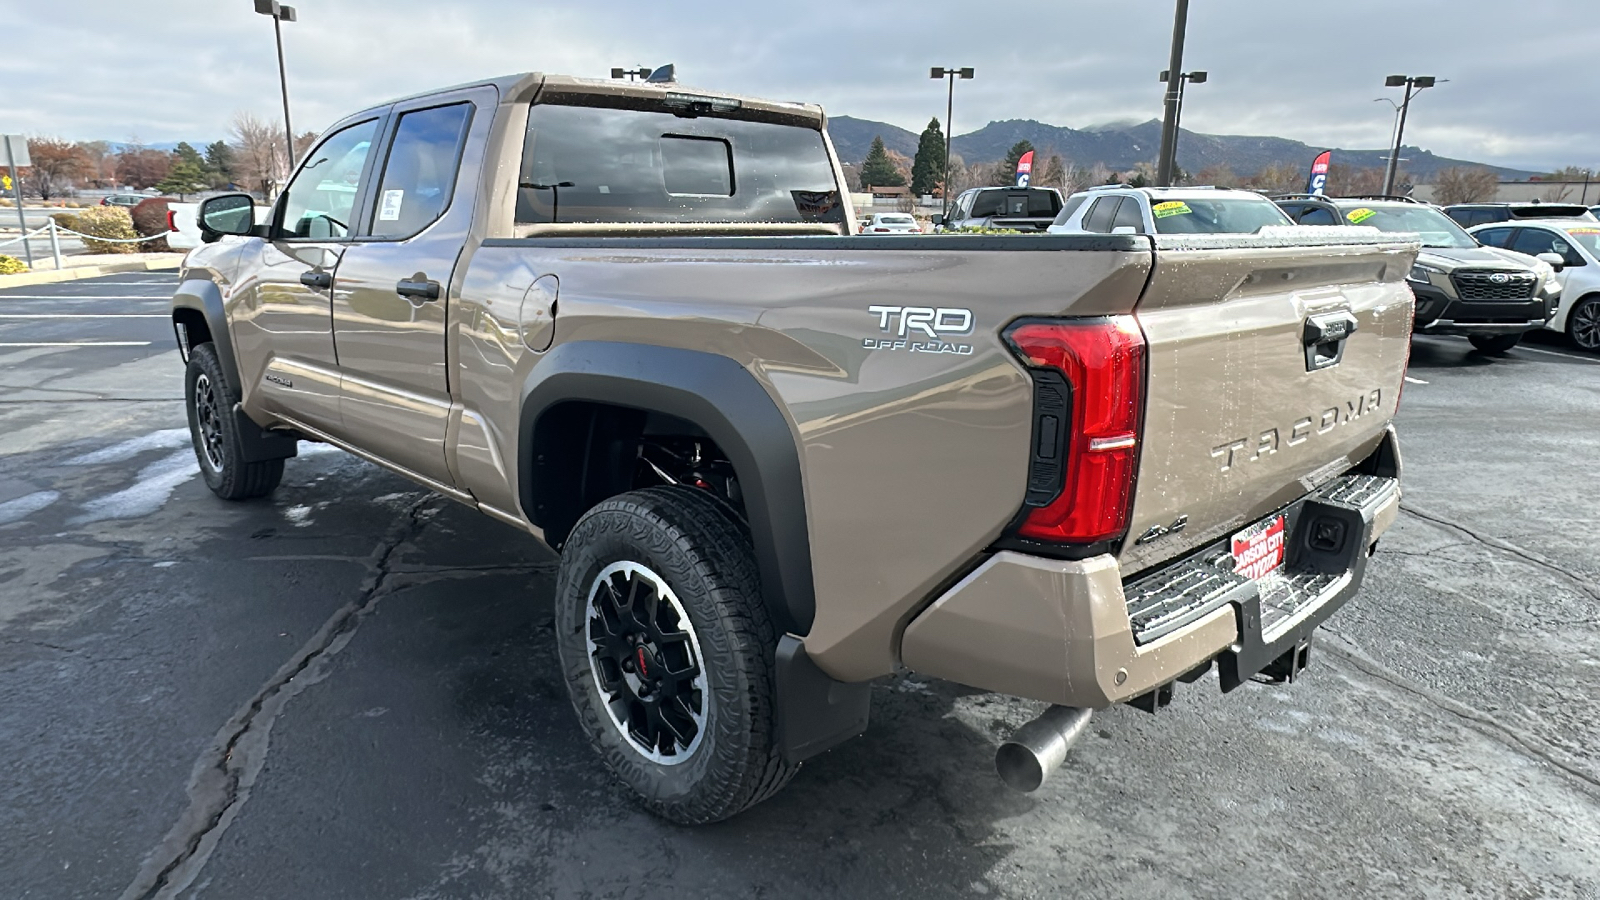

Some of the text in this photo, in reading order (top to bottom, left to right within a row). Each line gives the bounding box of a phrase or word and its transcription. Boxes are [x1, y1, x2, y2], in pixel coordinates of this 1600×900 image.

[867, 305, 975, 341] TRD
[862, 338, 974, 356] OFF ROAD
[1211, 388, 1381, 472] TACOMA
[1266, 530, 1284, 553] CITY
